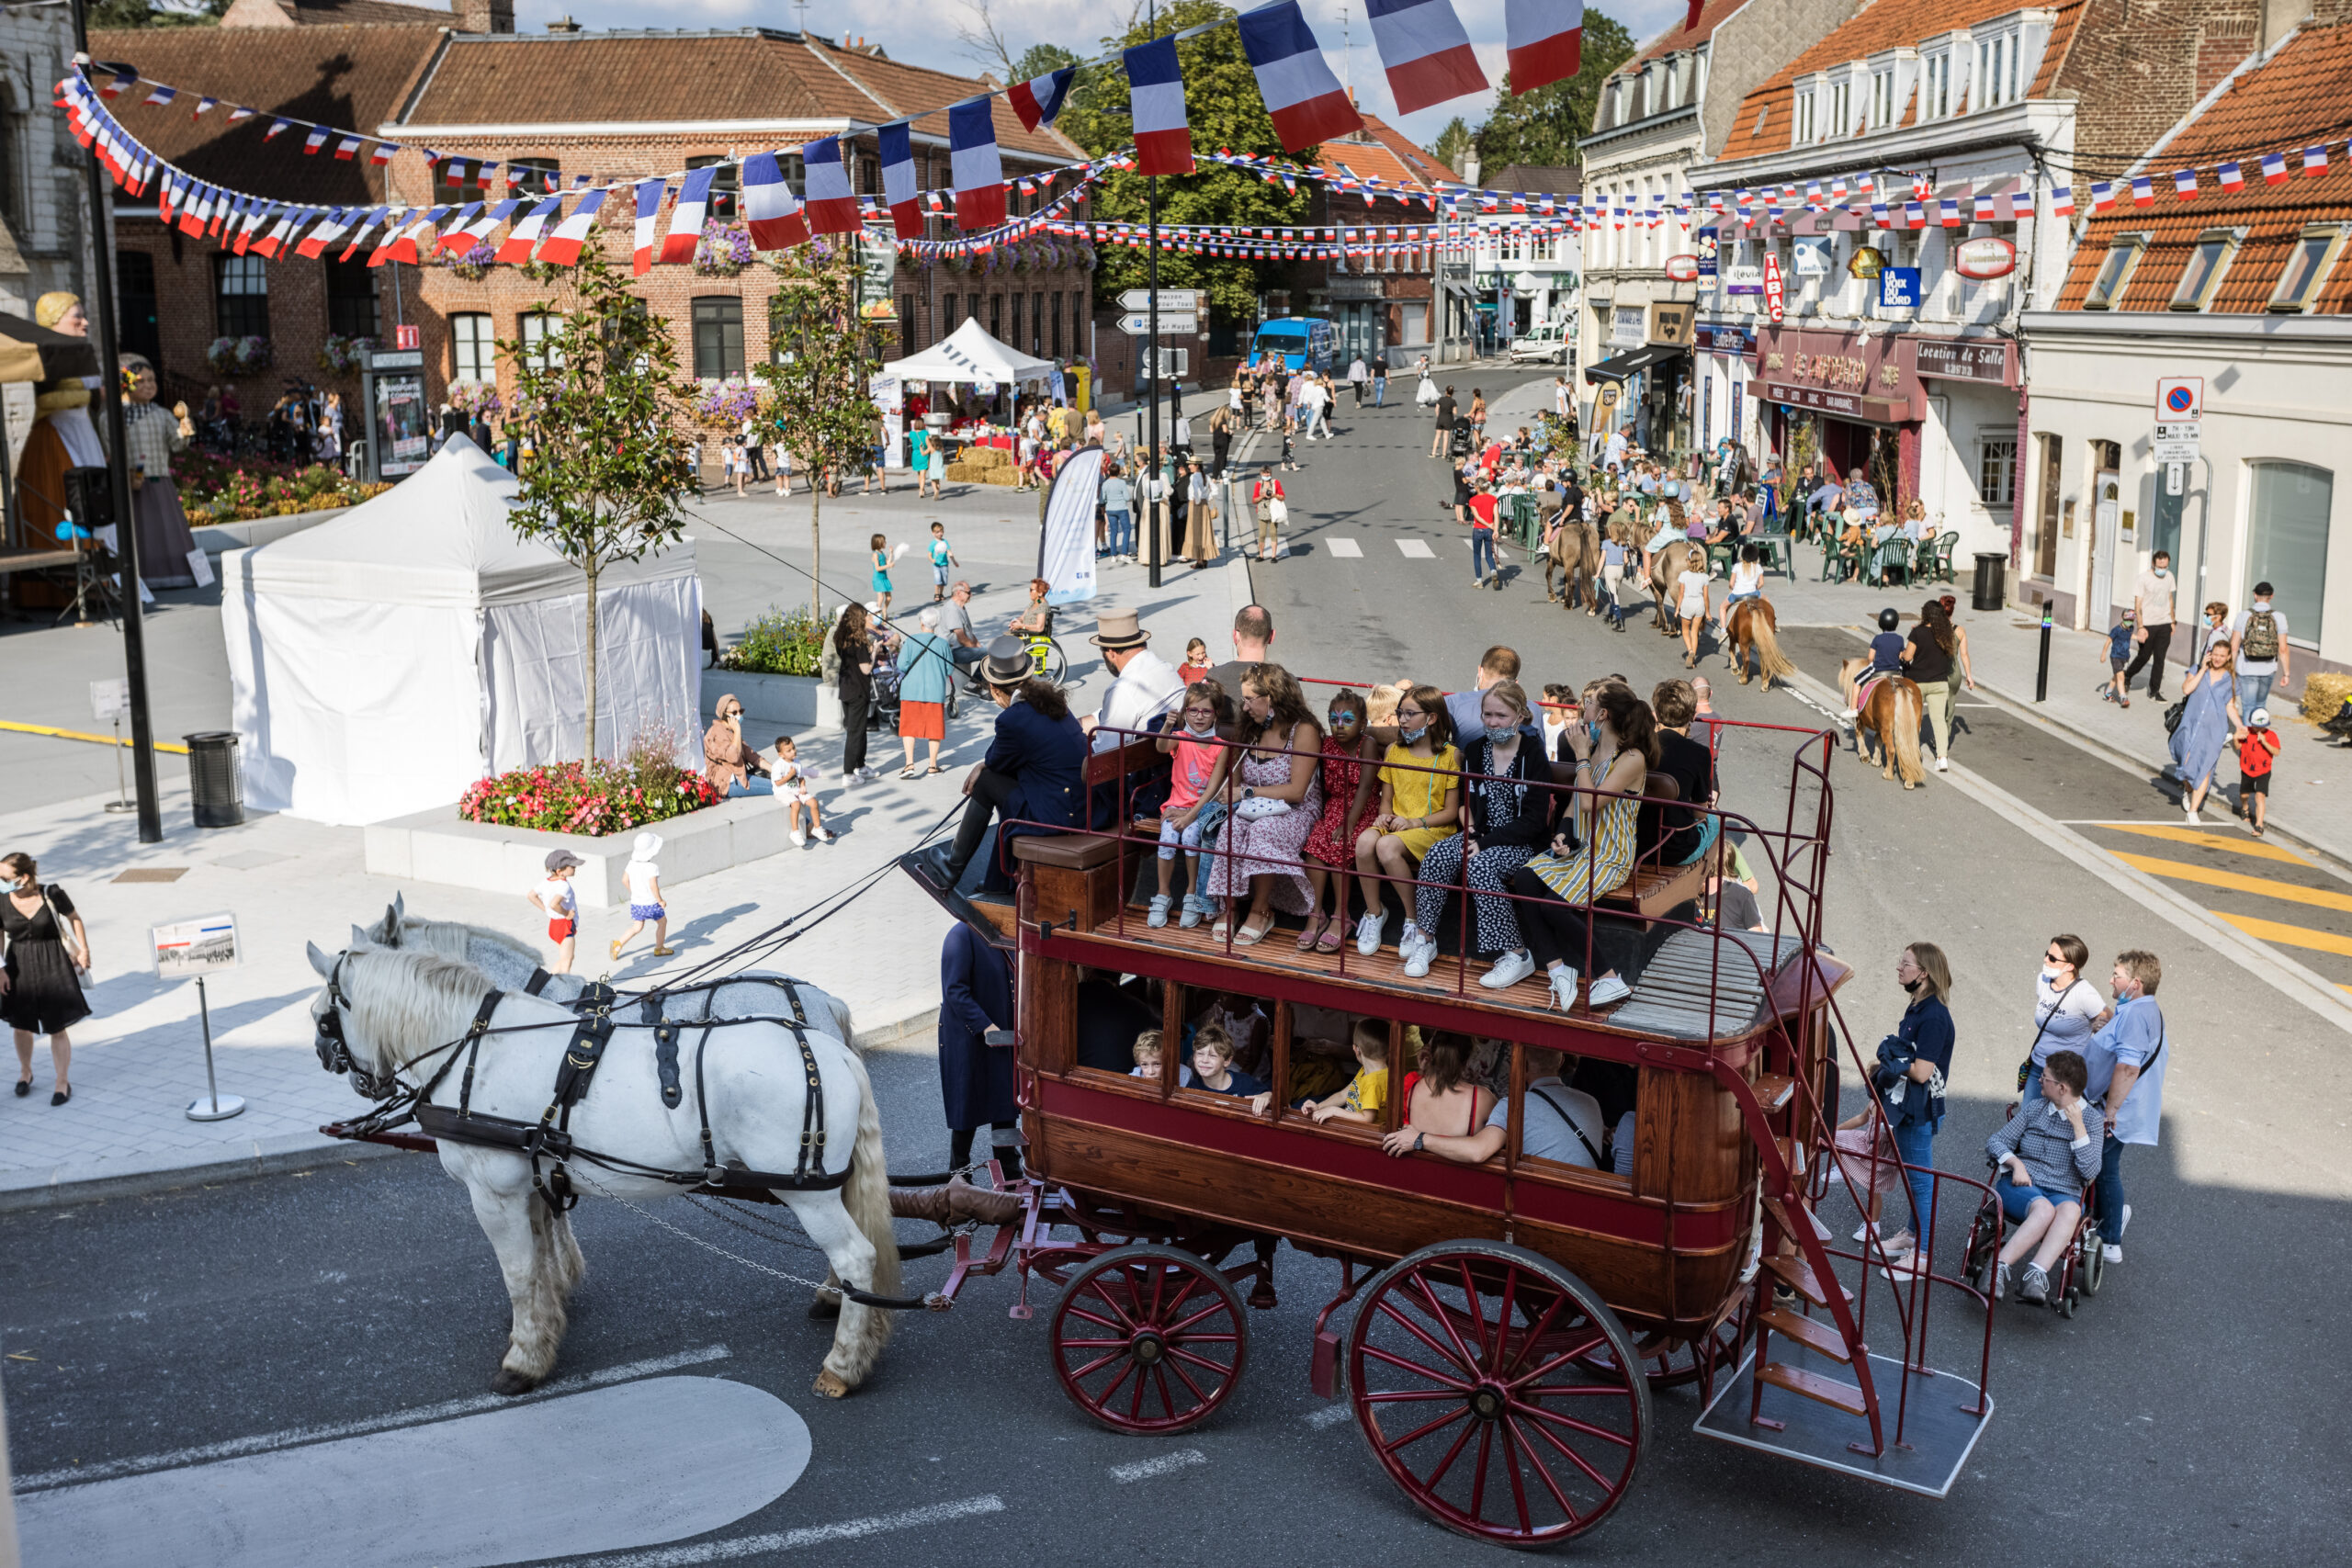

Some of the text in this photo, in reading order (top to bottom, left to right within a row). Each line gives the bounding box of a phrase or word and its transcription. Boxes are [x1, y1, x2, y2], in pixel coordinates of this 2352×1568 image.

[1884, 270, 1896, 279] LA
[1766, 254, 1783, 321] TABAC
[1884, 278, 1907, 288] VOIX
[1884, 288, 1899, 297] DU
[1883, 295, 1911, 305] NORD
[1918, 344, 2004, 365] Location de Salle
